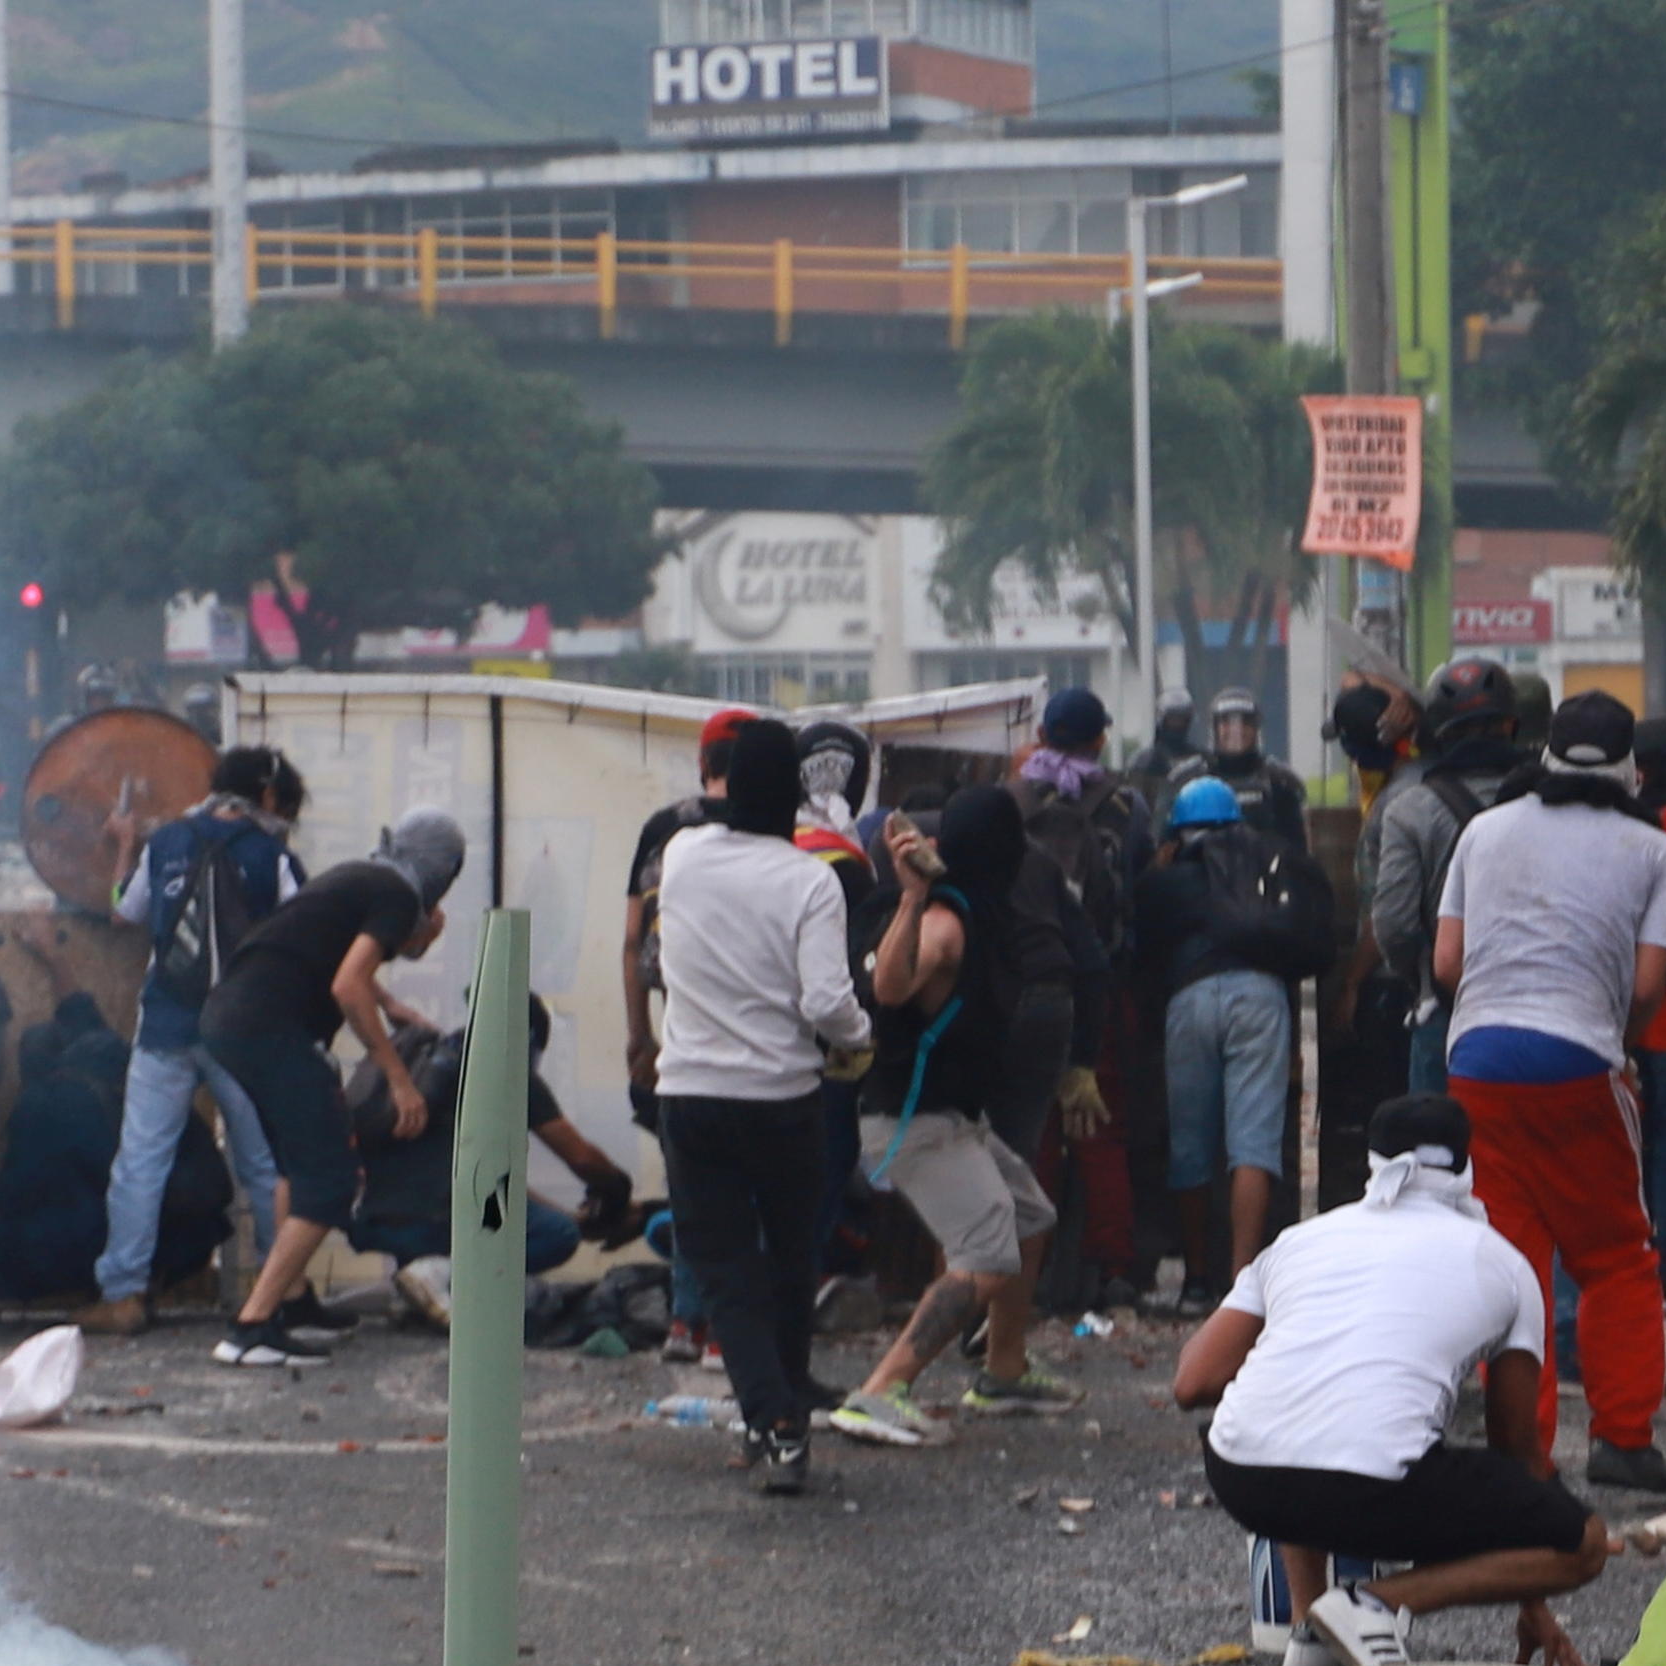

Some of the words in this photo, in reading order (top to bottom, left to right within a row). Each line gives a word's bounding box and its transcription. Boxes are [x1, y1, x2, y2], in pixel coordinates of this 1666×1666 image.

[653, 41, 879, 104] HOTEL
[739, 540, 865, 569] HOTEL
[735, 575, 774, 605] LA
[785, 573, 867, 604] LUNA
